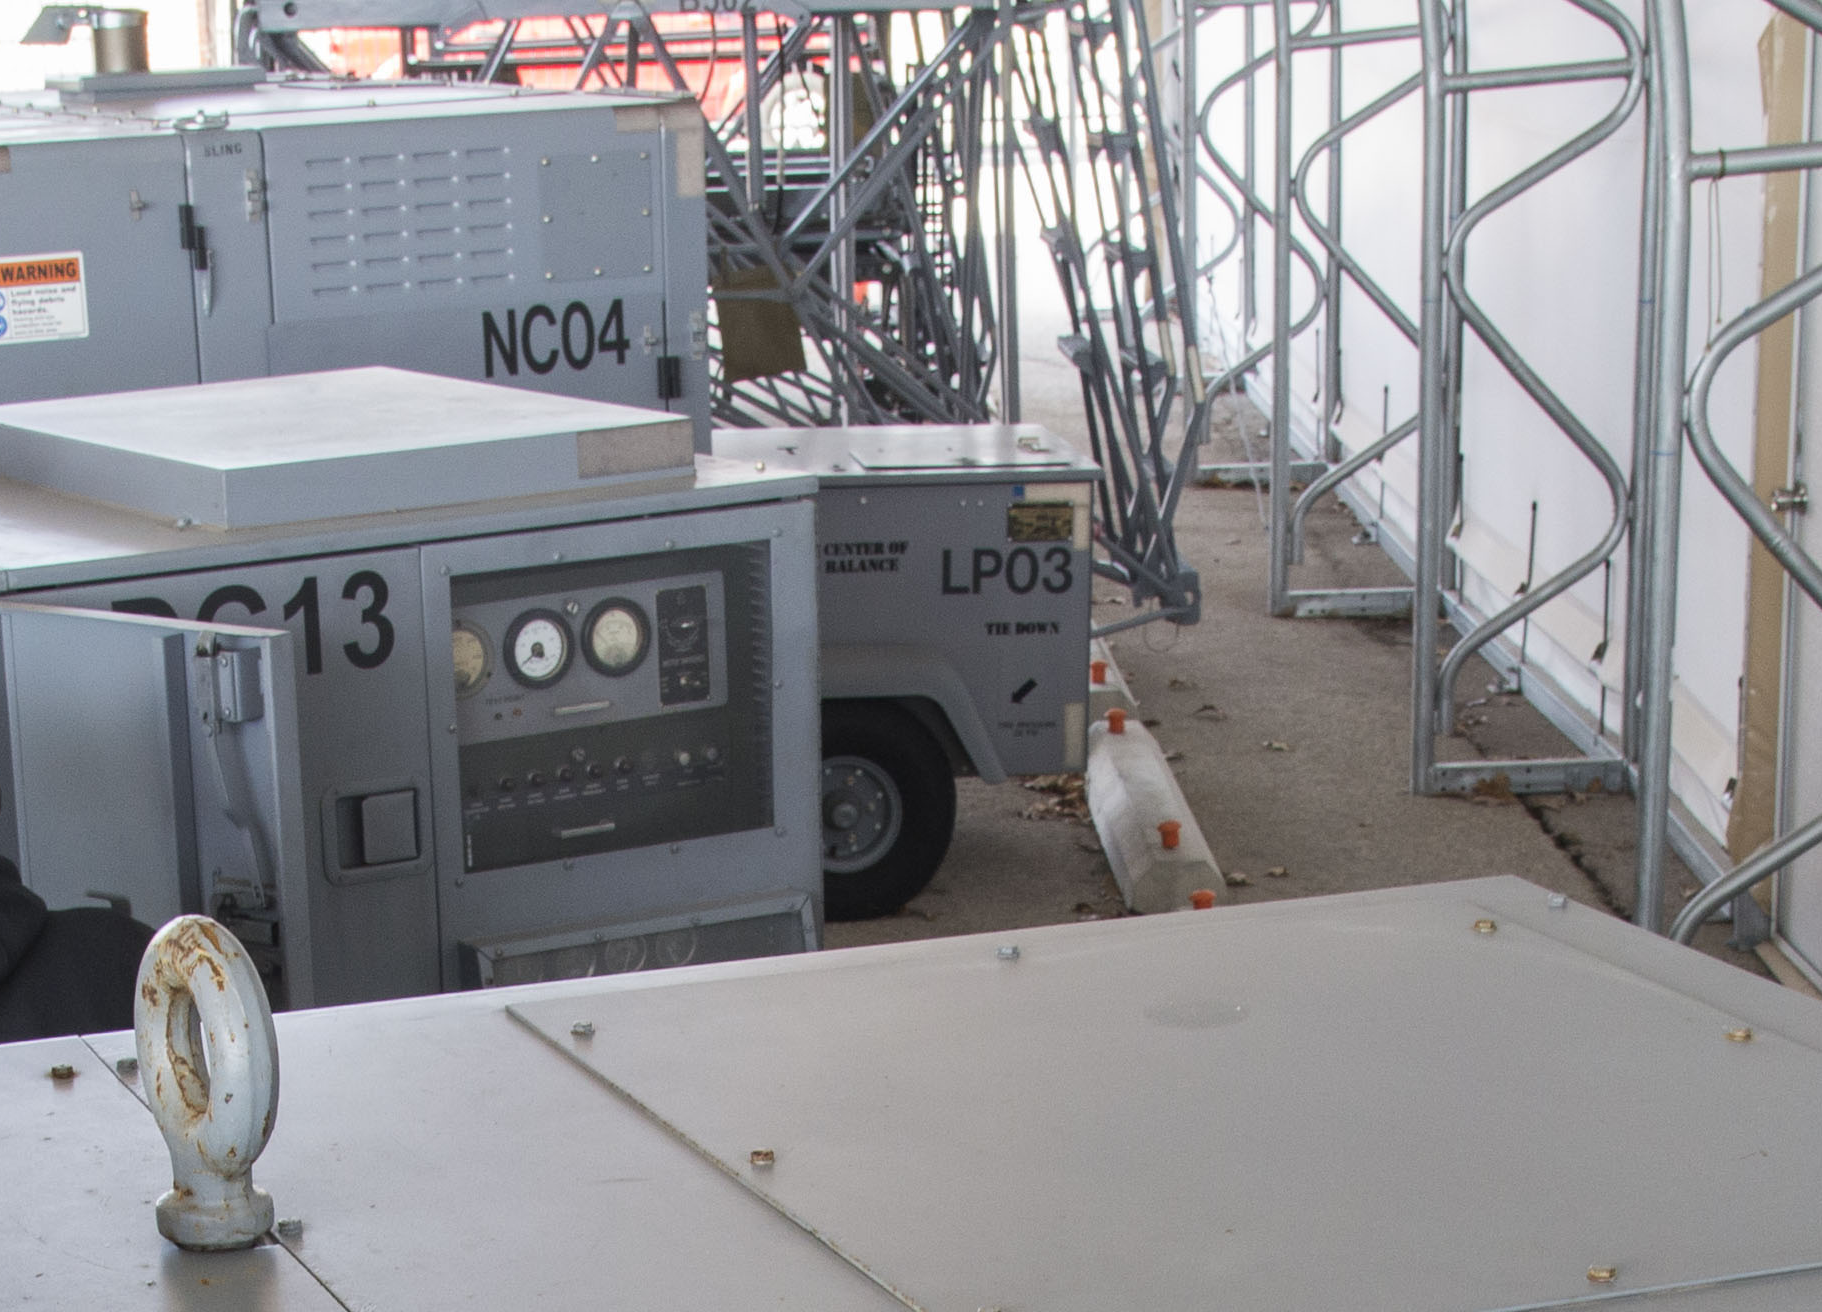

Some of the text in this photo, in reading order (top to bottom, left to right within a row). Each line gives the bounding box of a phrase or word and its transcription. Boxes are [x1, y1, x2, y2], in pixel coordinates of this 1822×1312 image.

[1, 262, 76, 282] WARNING
[482, 298, 630, 378] NC04
[823, 541, 910, 557] CENTER OF
[824, 559, 898, 574] BALANCE
[942, 546, 1073, 595] LP03
[986, 621, 1059, 635] TIE DOWN
